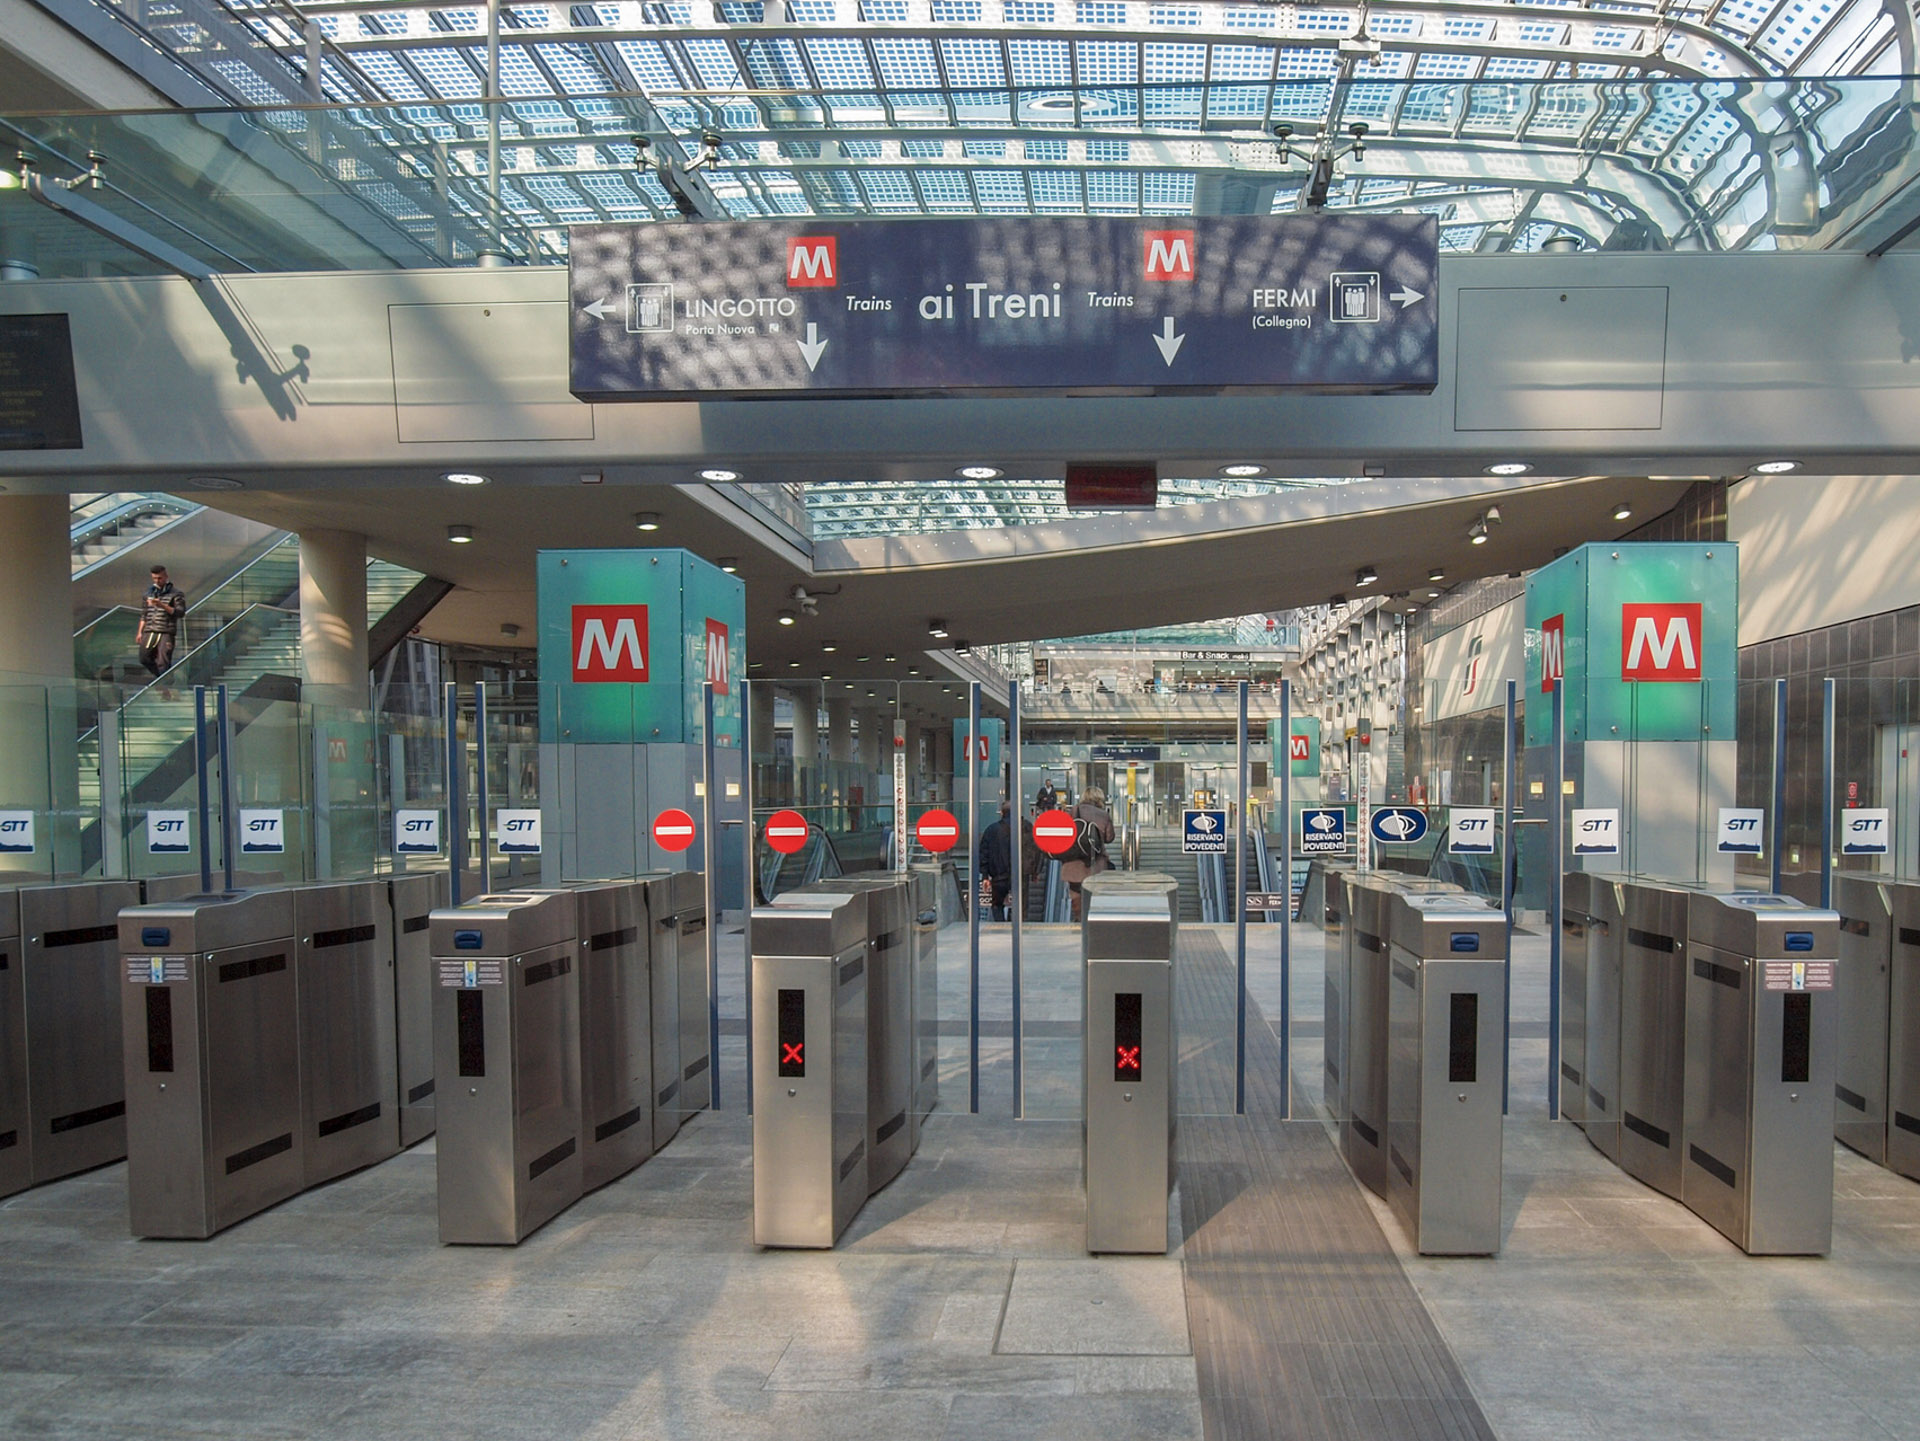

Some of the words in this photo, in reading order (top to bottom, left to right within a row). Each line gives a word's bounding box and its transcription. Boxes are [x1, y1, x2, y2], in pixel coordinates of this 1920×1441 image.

[790, 246, 833, 278] M
[1147, 240, 1190, 272] M
[685, 298, 796, 318] LINGOTTO
[846, 296, 892, 311] Trains
[920, 284, 953, 320] ai
[966, 283, 1061, 319] Treni
[1087, 292, 1134, 308] Trains
[1253, 288, 1317, 308] FERMI
[685, 324, 715, 336] Porta
[717, 324, 755, 335] Nuova
[1252, 315, 1312, 329] (Collegno)
[577, 618, 645, 670] M
[1626, 617, 1697, 669] M
[707, 631, 728, 684] M
[1182, 651, 1196, 660] Bar
[1197, 651, 1204, 660] &
[1205, 651, 1230, 660] Snack
[1543, 628, 1562, 680] M
[1186, 833, 1224, 842] RISERVATO
[1305, 832, 1343, 842] RISERVATO
